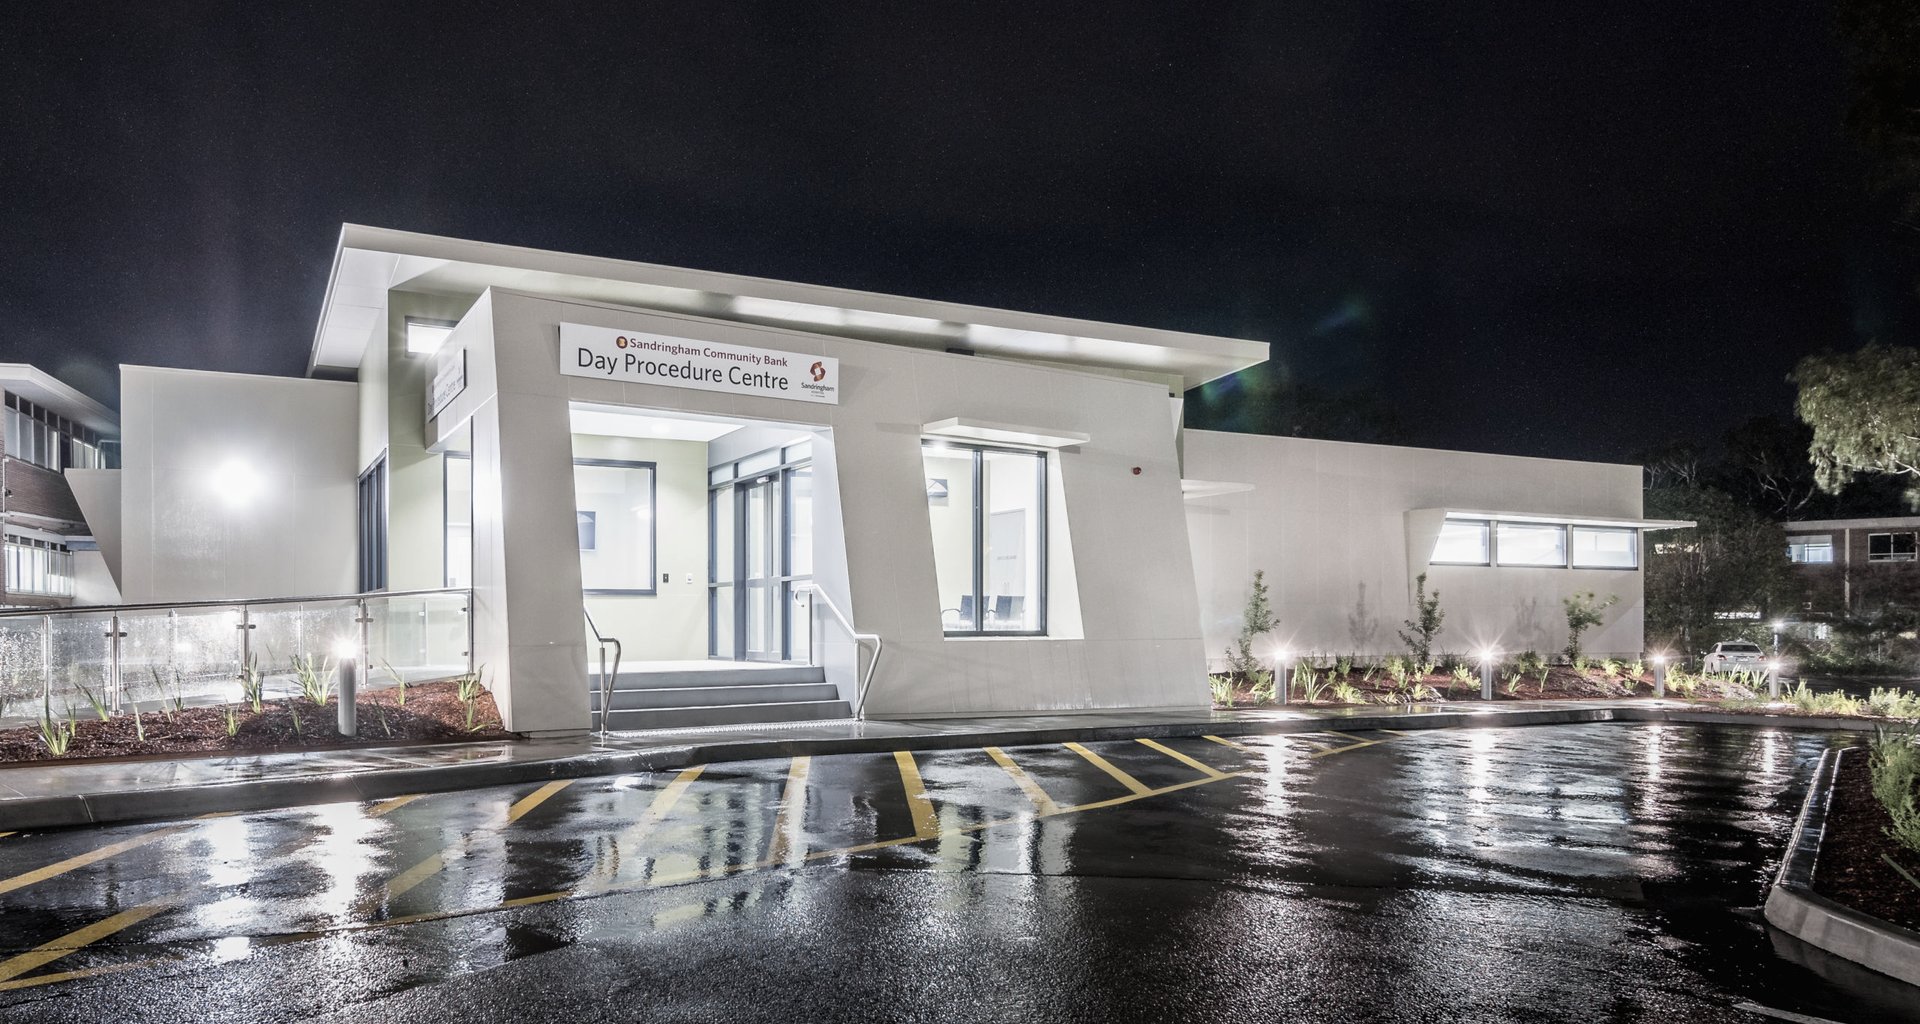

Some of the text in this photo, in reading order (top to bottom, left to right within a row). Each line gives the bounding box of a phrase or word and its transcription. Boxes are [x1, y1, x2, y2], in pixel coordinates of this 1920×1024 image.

[631, 338, 788, 368] Sandringham Community Bank
[578, 347, 789, 391] Day Procedure Centre
[801, 382, 834, 391] Sandringham
